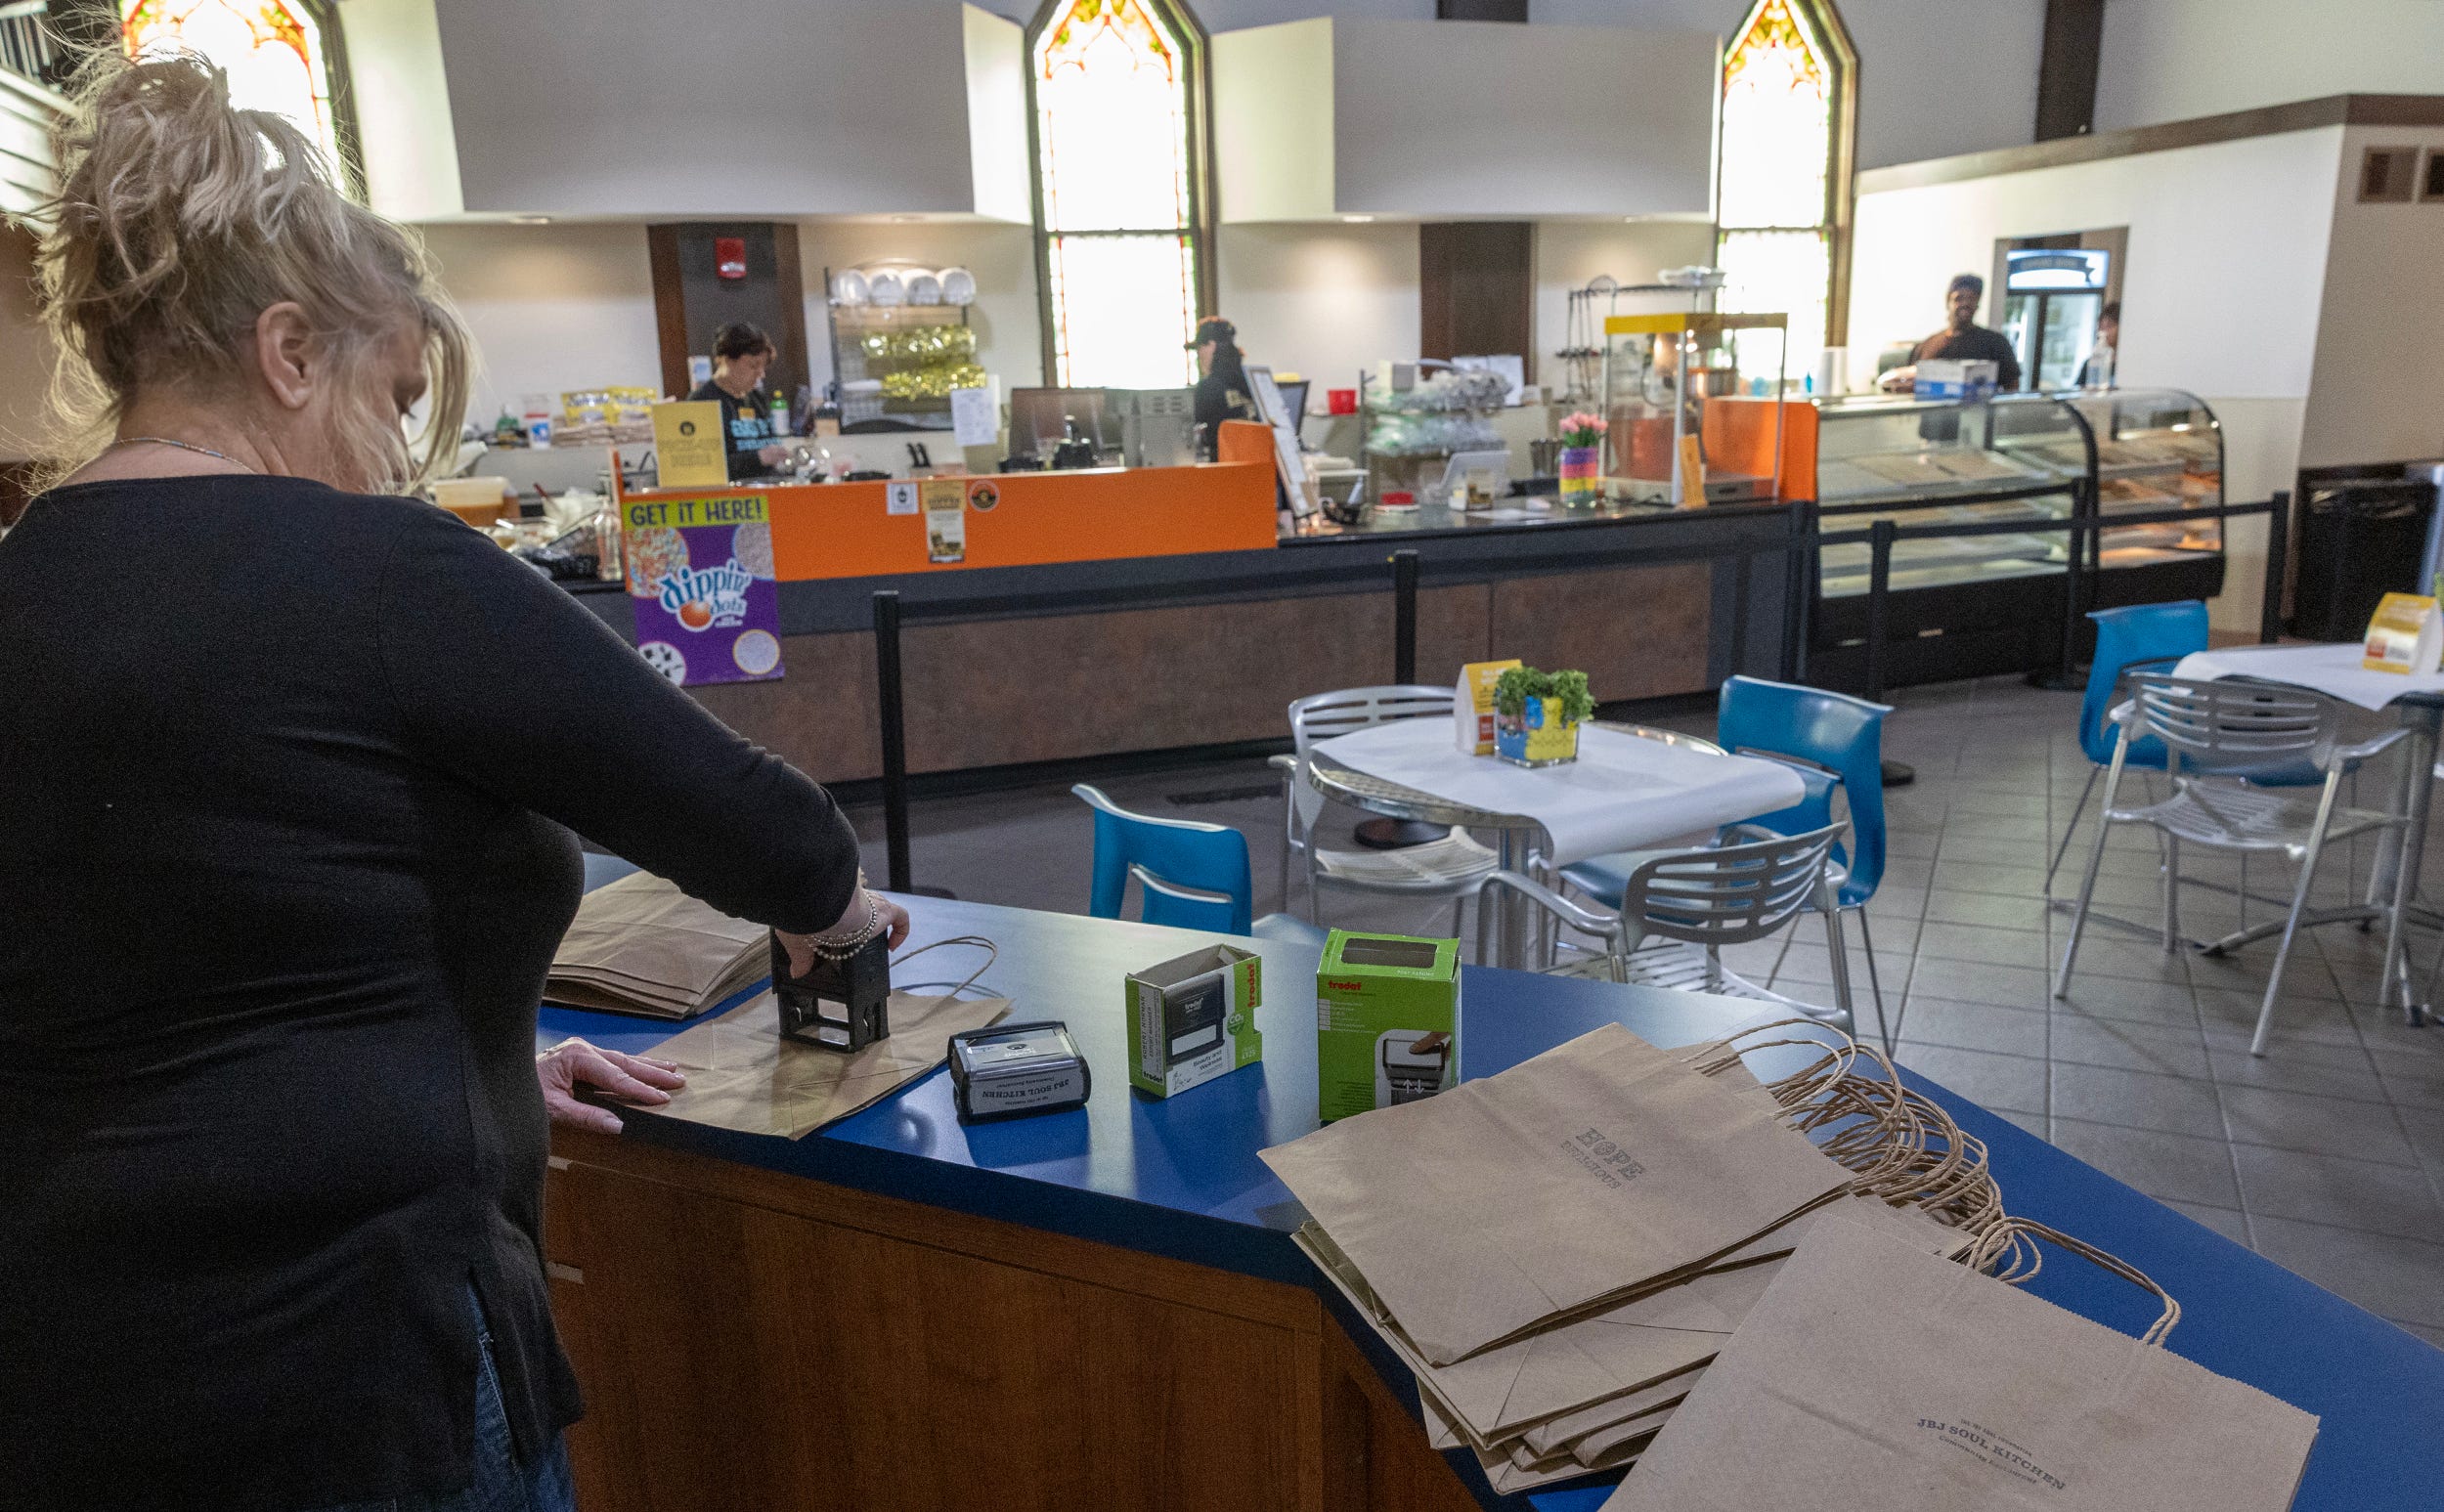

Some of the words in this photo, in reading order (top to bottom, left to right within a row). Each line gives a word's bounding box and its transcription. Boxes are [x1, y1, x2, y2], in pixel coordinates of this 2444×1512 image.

[630, 503, 668, 526] GET
[705, 497, 763, 521] HERE!
[709, 598, 744, 616] dots
[1246, 963, 1256, 1008] trodat
[1328, 980, 1362, 990] trodat
[1193, 1054, 1212, 1067] Beauty
[1053, 1079, 1069, 1091] JBJ
[1143, 1070, 1163, 1084] trodat
[982, 1090, 1026, 1099] KITCHEN
[1027, 1086, 1053, 1096] SOUL
[1575, 1127, 1645, 1181] HOPE
[1917, 1418, 1945, 1431] JBJ
[1948, 1426, 1988, 1449] SOUL
[1992, 1445, 2066, 1490] KITCHEN
[1939, 1435, 1987, 1463] Community
